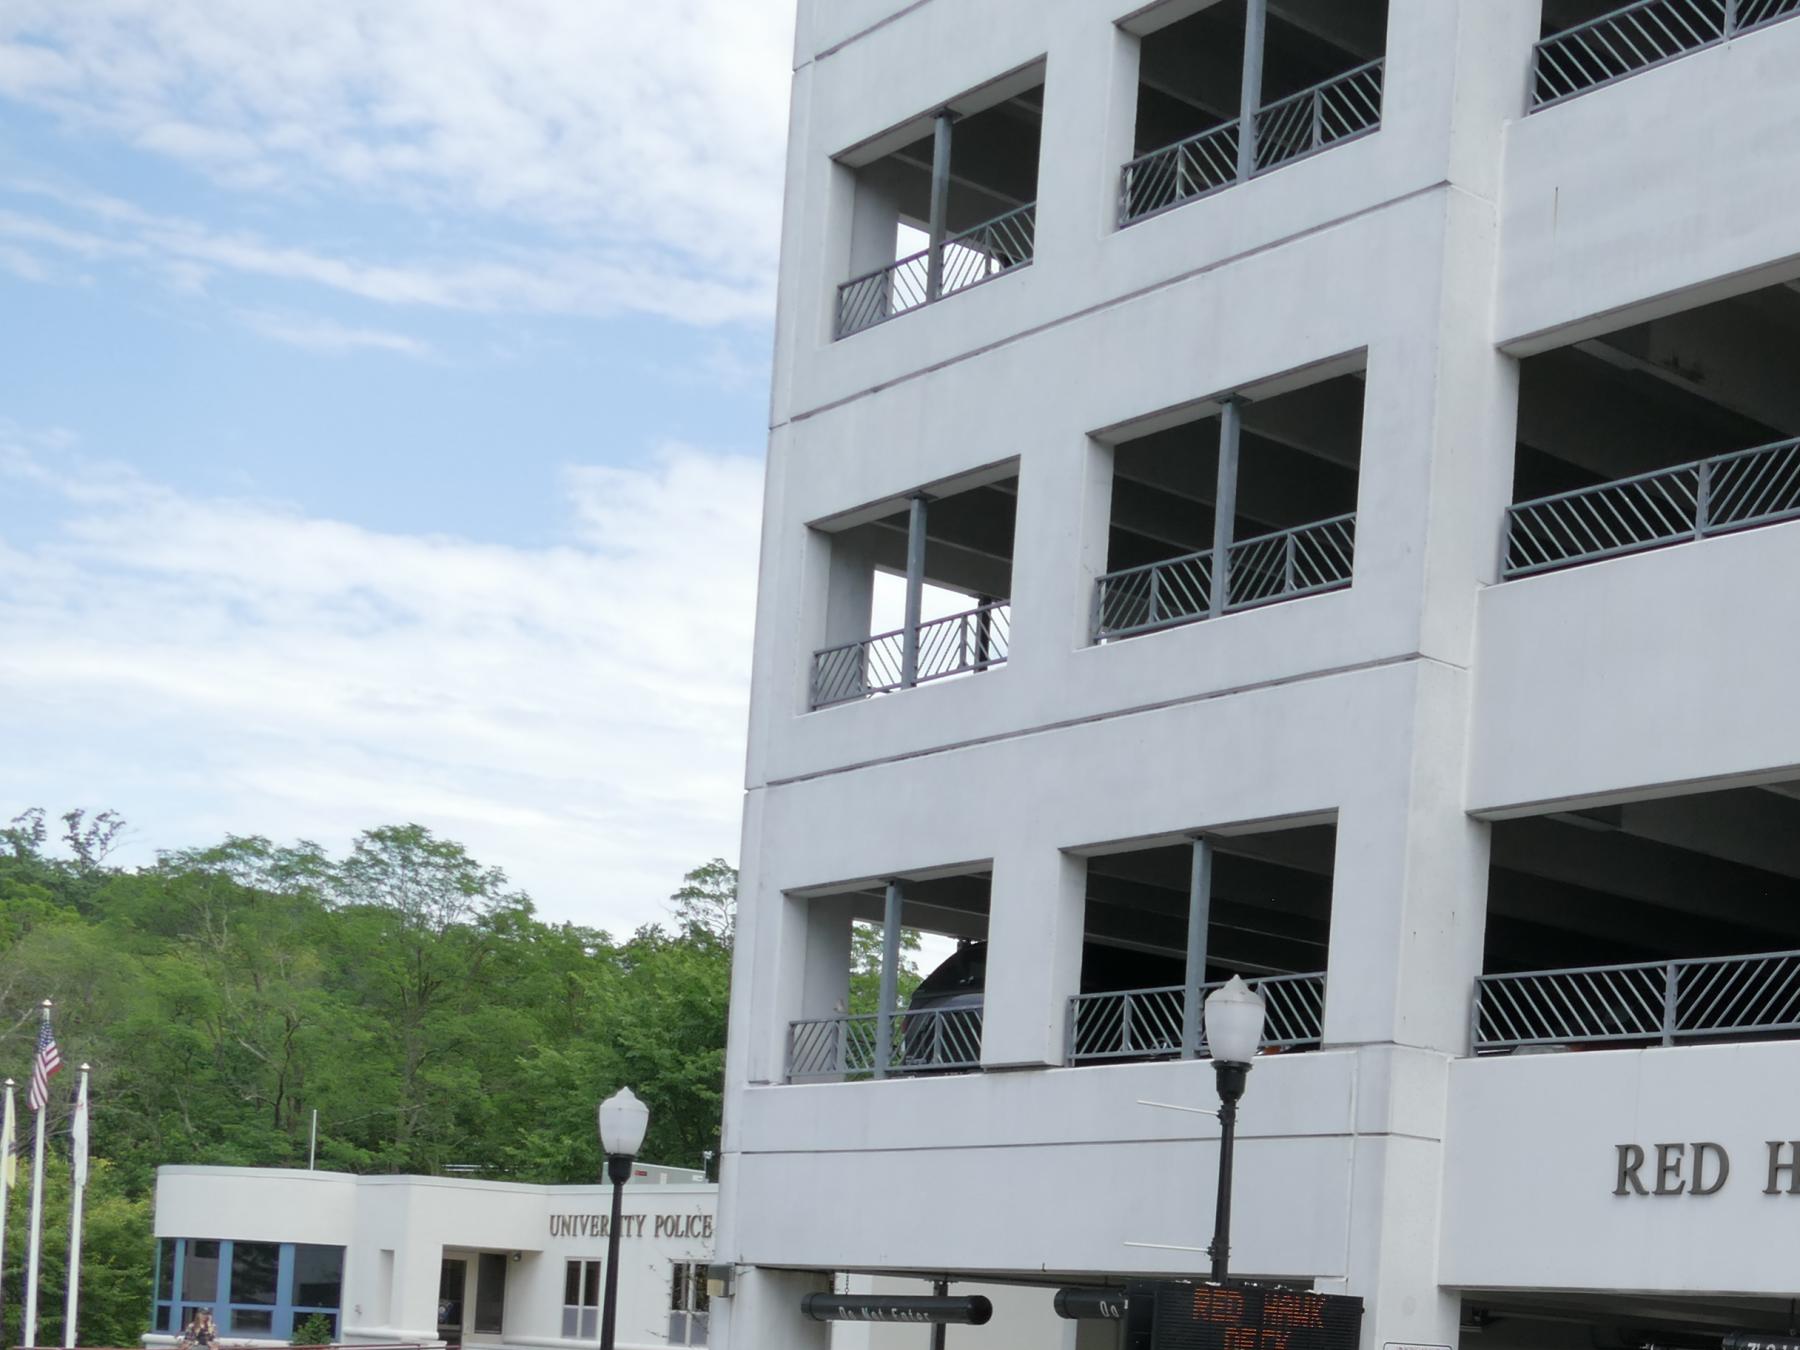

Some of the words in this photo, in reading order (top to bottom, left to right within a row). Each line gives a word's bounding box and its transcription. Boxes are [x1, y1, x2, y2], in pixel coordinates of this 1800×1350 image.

[1612, 1141, 1729, 1196] RED
[550, 1214, 647, 1238] UNIVERITY
[654, 1214, 713, 1239] POLICE
